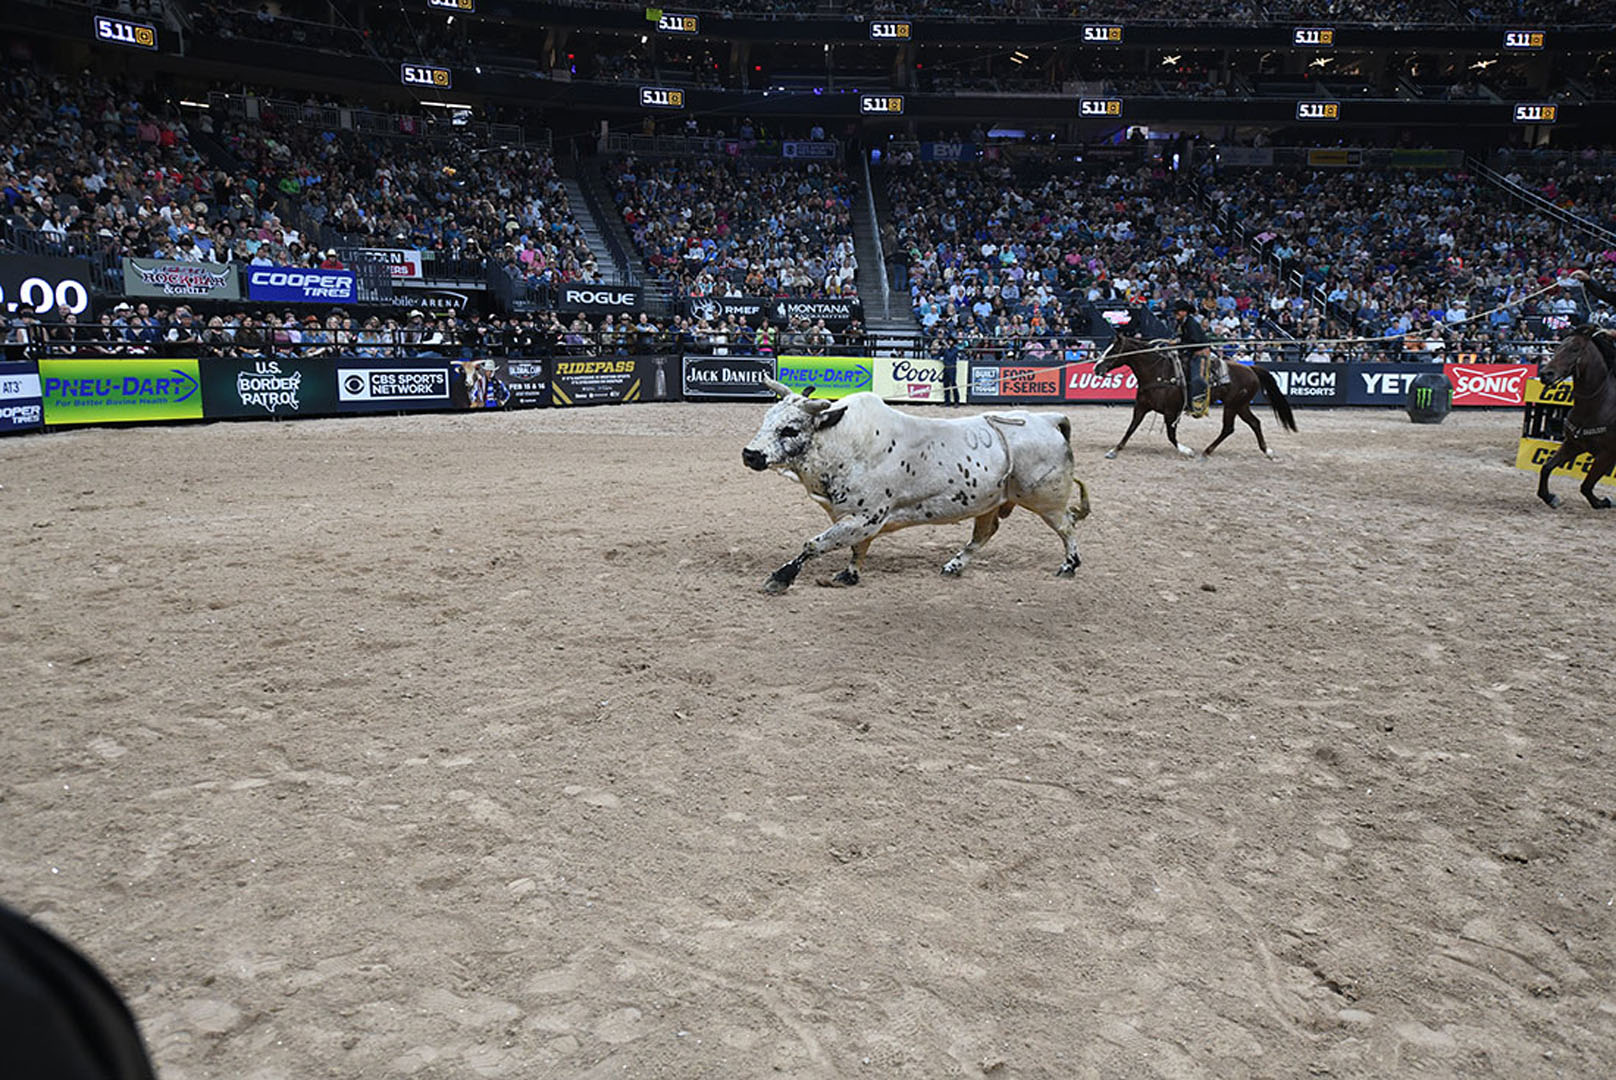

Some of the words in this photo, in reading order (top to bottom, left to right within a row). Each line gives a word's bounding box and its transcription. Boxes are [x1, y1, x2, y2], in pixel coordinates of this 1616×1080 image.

[658, 15, 685, 31] 5.11
[99, 20, 136, 43] 5.11
[872, 24, 898, 38] 5.11
[1084, 27, 1109, 41] 5.11
[1295, 30, 1321, 44] 5.11
[1505, 33, 1531, 47] 5.11
[404, 67, 434, 85] 5.11
[642, 90, 670, 105] 5.11
[863, 97, 889, 112] 5.11
[1081, 101, 1108, 115] 5.11
[1299, 104, 1326, 118] 5.11
[1516, 106, 1542, 120] 5.11
[251, 271, 352, 289] COOPER
[0, 277, 88, 315] .00
[303, 287, 350, 298] TIRES
[566, 290, 635, 306] ROGUE
[421, 299, 461, 308] ARENA
[725, 306, 761, 315] RMEF
[788, 303, 849, 314] MONTANA
[255, 361, 282, 374] U.S.
[556, 361, 636, 375] RIDEPASS
[778, 367, 862, 382] PNEU-DART
[371, 374, 396, 384] CBS
[397, 374, 444, 384] SPORTS
[687, 367, 719, 383] JACK
[1003, 369, 1035, 381] FORD
[1068, 373, 1123, 389] LUCAS
[1290, 371, 1337, 387] MGM
[44, 376, 185, 398] PNEU-DART
[240, 377, 300, 391] BORDER
[372, 384, 434, 395] NETWORK
[1002, 381, 1057, 393] F-SERIES
[1361, 372, 1418, 394] YET
[1456, 376, 1521, 394] SONIC
[243, 391, 299, 405] PATROL
[1290, 387, 1336, 396] RESORTS
[0, 405, 41, 418] OPER
